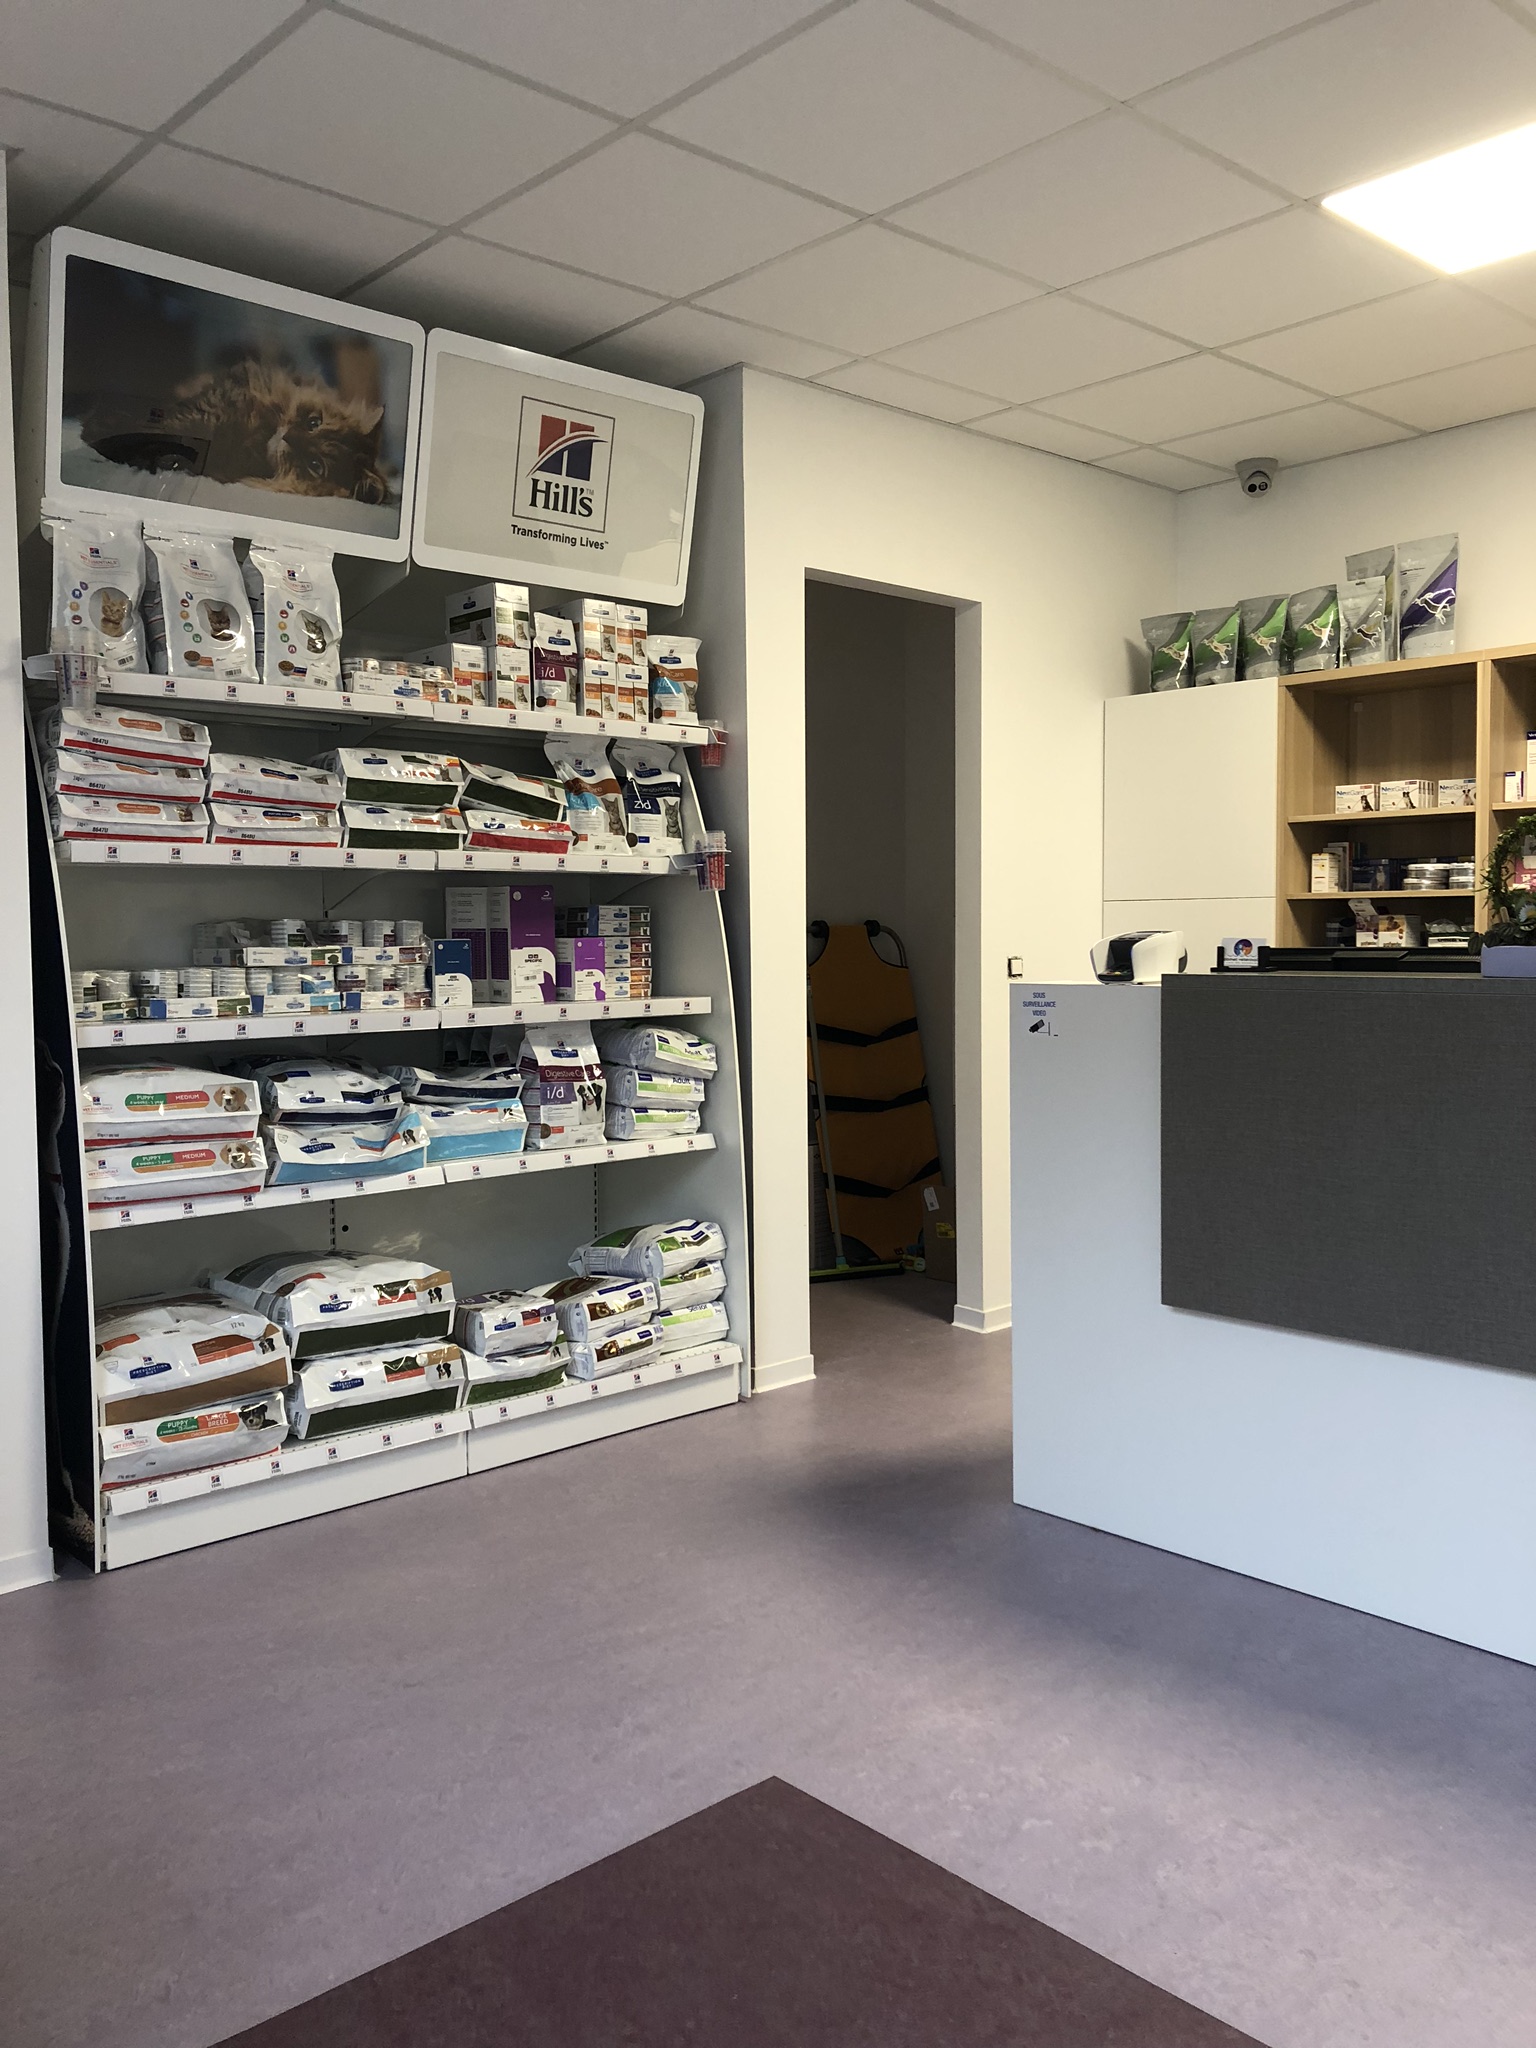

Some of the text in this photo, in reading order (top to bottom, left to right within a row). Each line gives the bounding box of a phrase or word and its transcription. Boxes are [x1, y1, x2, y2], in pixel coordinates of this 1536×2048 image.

[511, 524, 577, 547] Transforming
[541, 666, 556, 678] i/d
[545, 1069, 575, 1080] Digestive
[175, 1093, 200, 1101] MEDIUM
[547, 1086, 565, 1099] i/d
[182, 1152, 206, 1160] MEDIUM
[132, 1364, 168, 1376] PRESCRIPTION
[167, 1419, 189, 1429] PUPPY
[183, 1424, 198, 1432] months
[207, 1418, 229, 1428] BREED
[122, 1439, 149, 1449] ESSENTIALS
